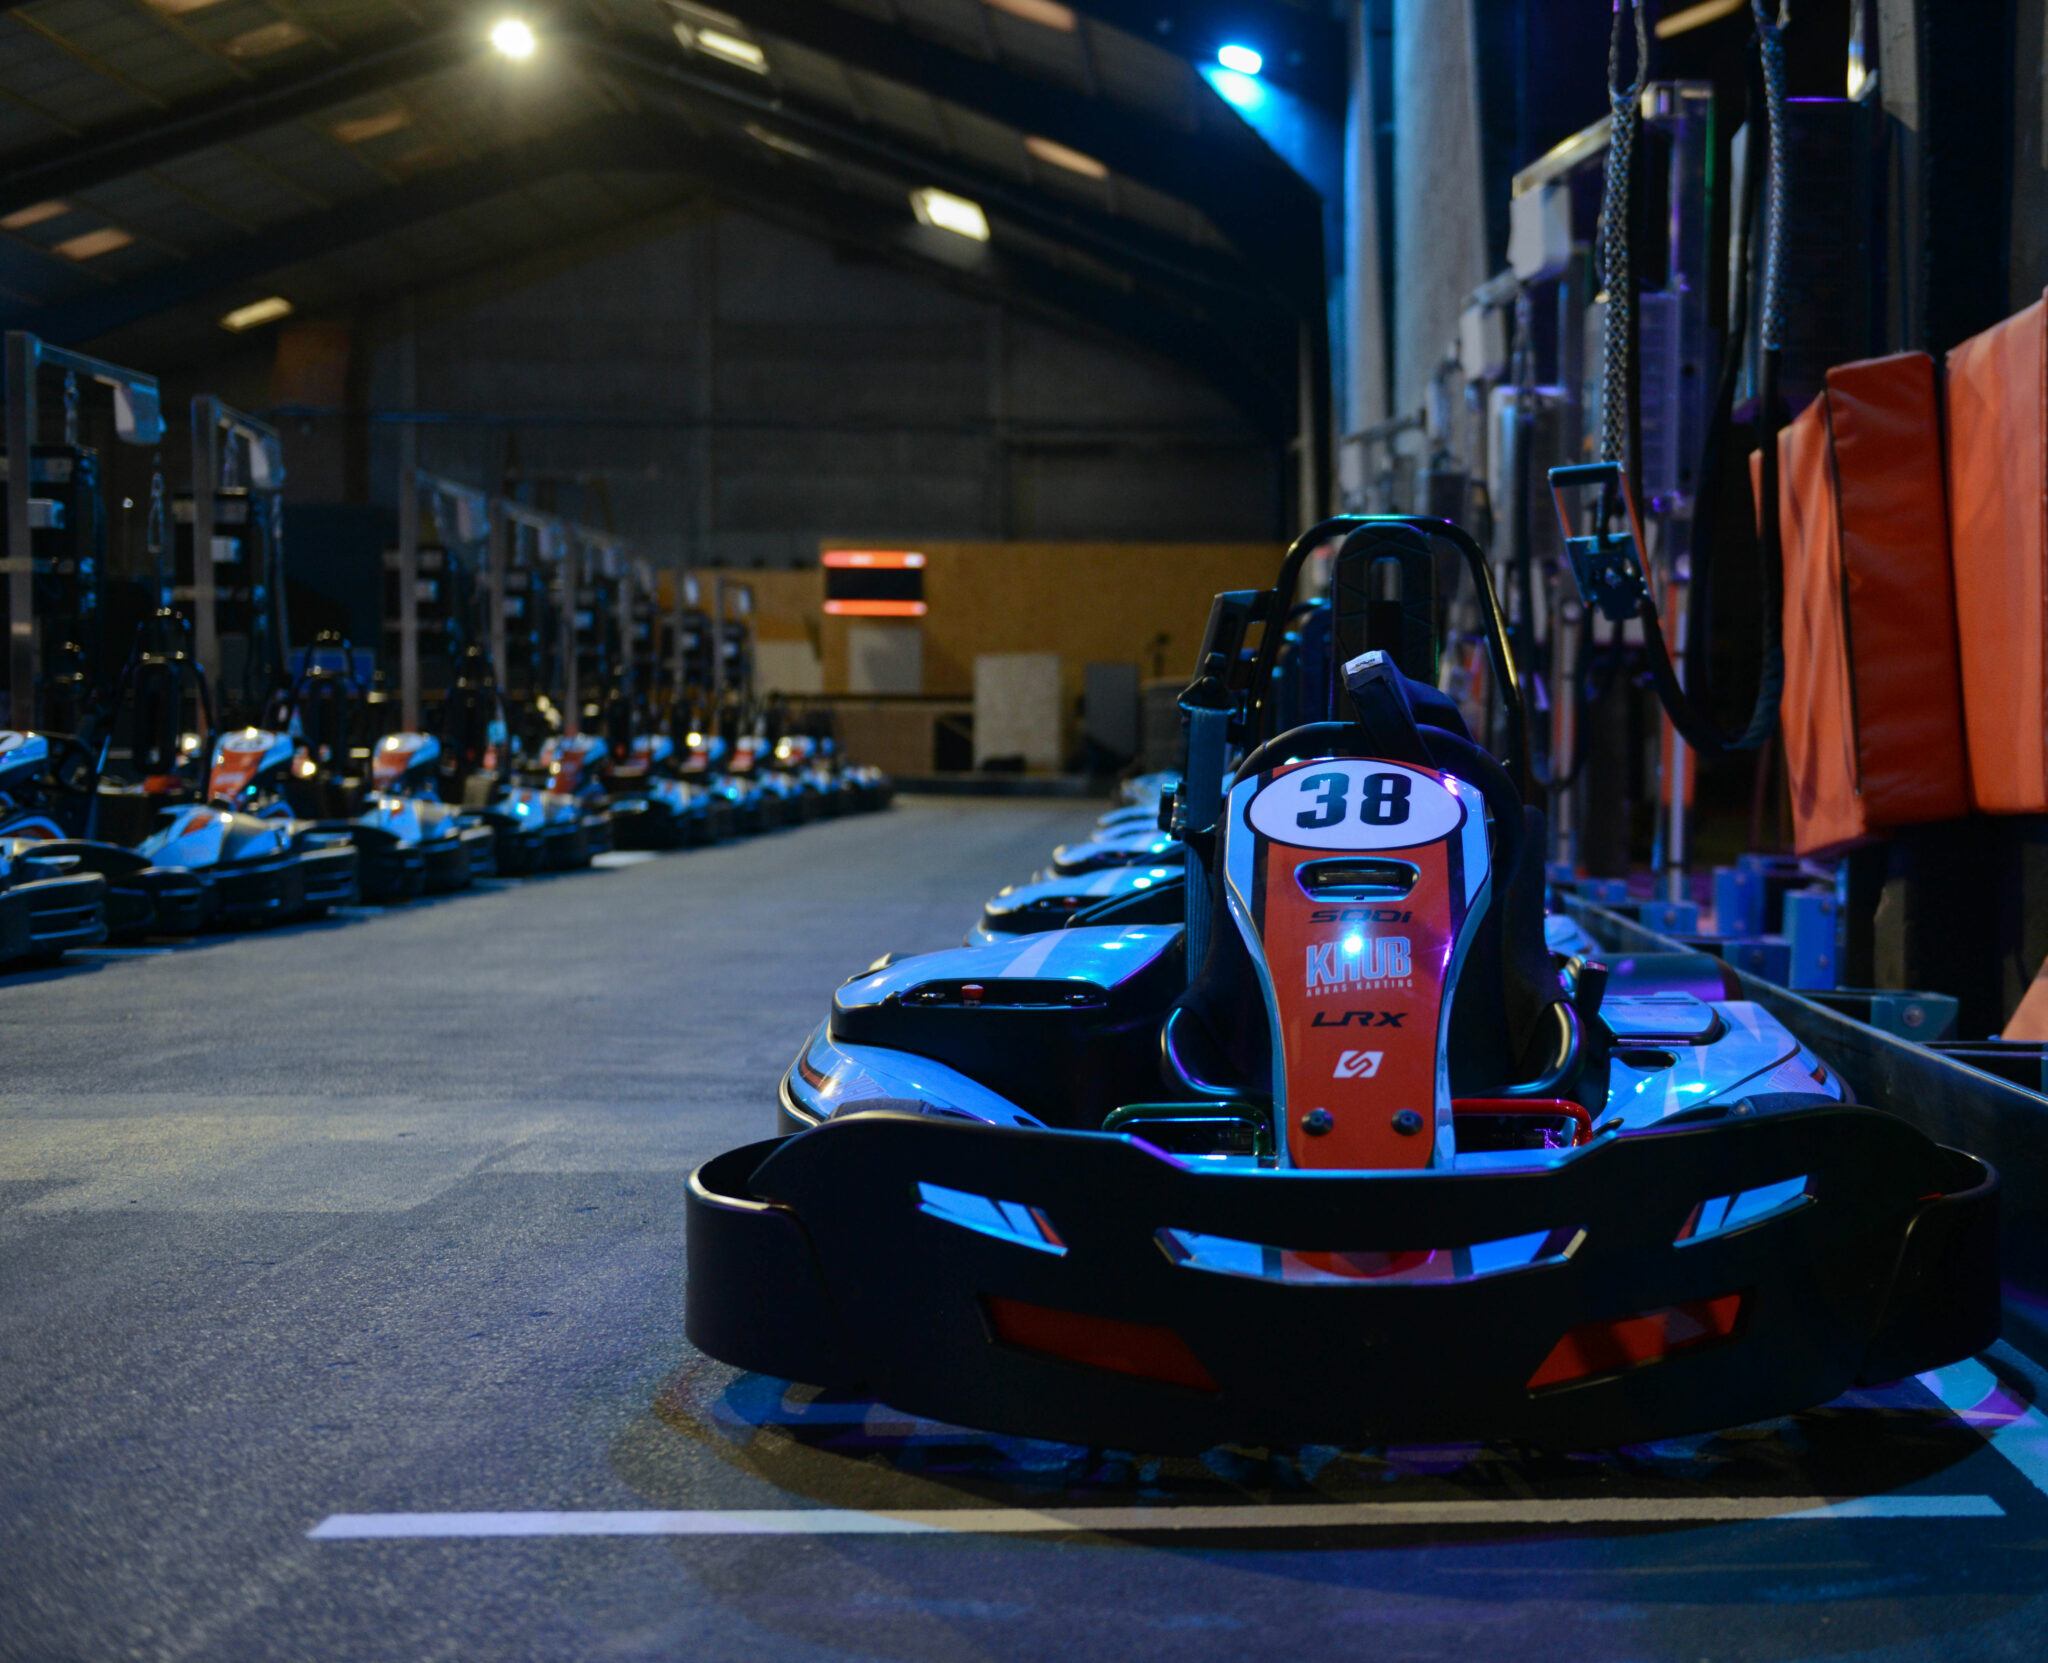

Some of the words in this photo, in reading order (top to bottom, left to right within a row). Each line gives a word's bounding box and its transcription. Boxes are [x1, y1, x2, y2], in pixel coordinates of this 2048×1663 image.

[1296, 772, 1412, 830] 38
[1309, 909, 1413, 924] SODI
[1306, 936, 1412, 988] KHUB
[1356, 979, 1413, 991] KARTING
[1311, 1011, 1408, 1028] LRX
